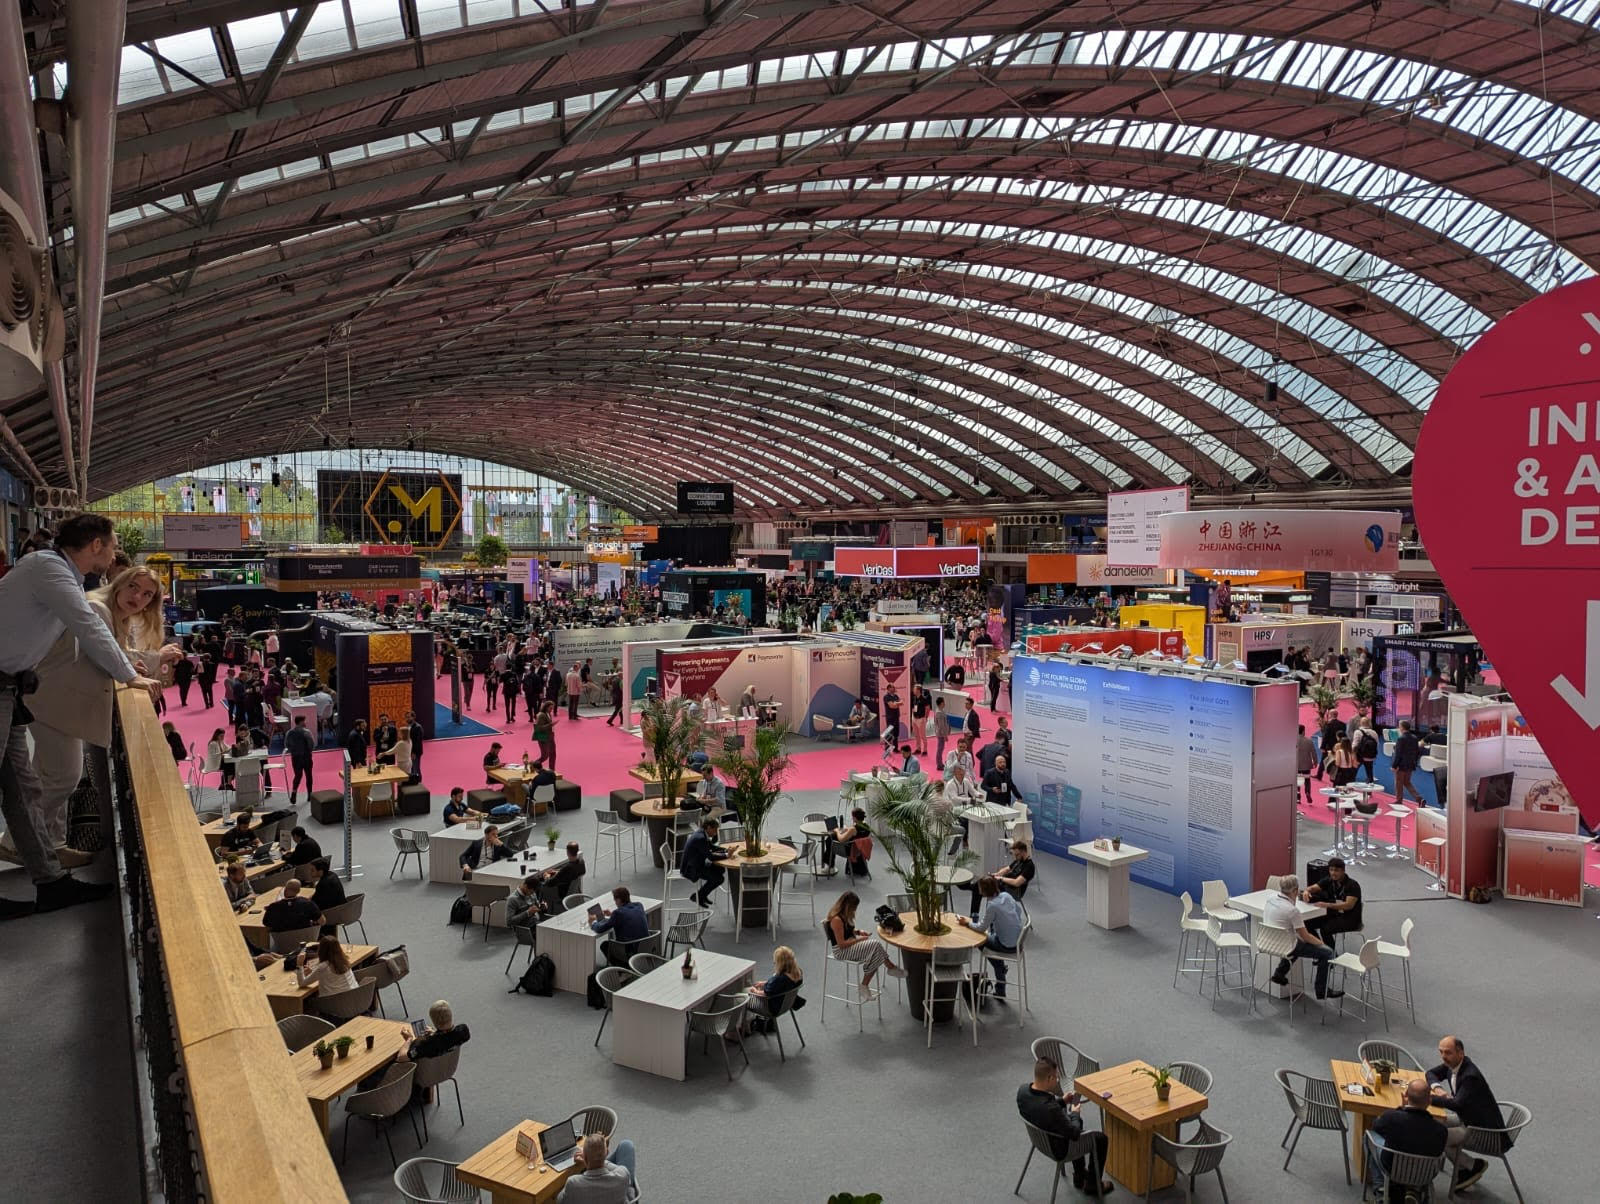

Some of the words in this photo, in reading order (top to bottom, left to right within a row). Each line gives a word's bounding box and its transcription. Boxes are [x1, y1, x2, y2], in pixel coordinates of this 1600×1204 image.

[1513, 457, 1549, 498] &
[1199, 519, 1283, 540] 中国浙江
[1520, 505, 1600, 546] DE
[1198, 543, 1282, 552] ZHEJIANG-CHINA
[863, 564, 893, 576] VeriDas
[938, 563, 979, 575] VeriDas
[1103, 565, 1154, 577] dandelion
[1230, 592, 1263, 602] ntellect
[1407, 640, 1430, 648] MONEY
[1431, 642, 1455, 650] MOVES
[672, 659, 700, 667] Powering
[701, 657, 730, 666] Payments
